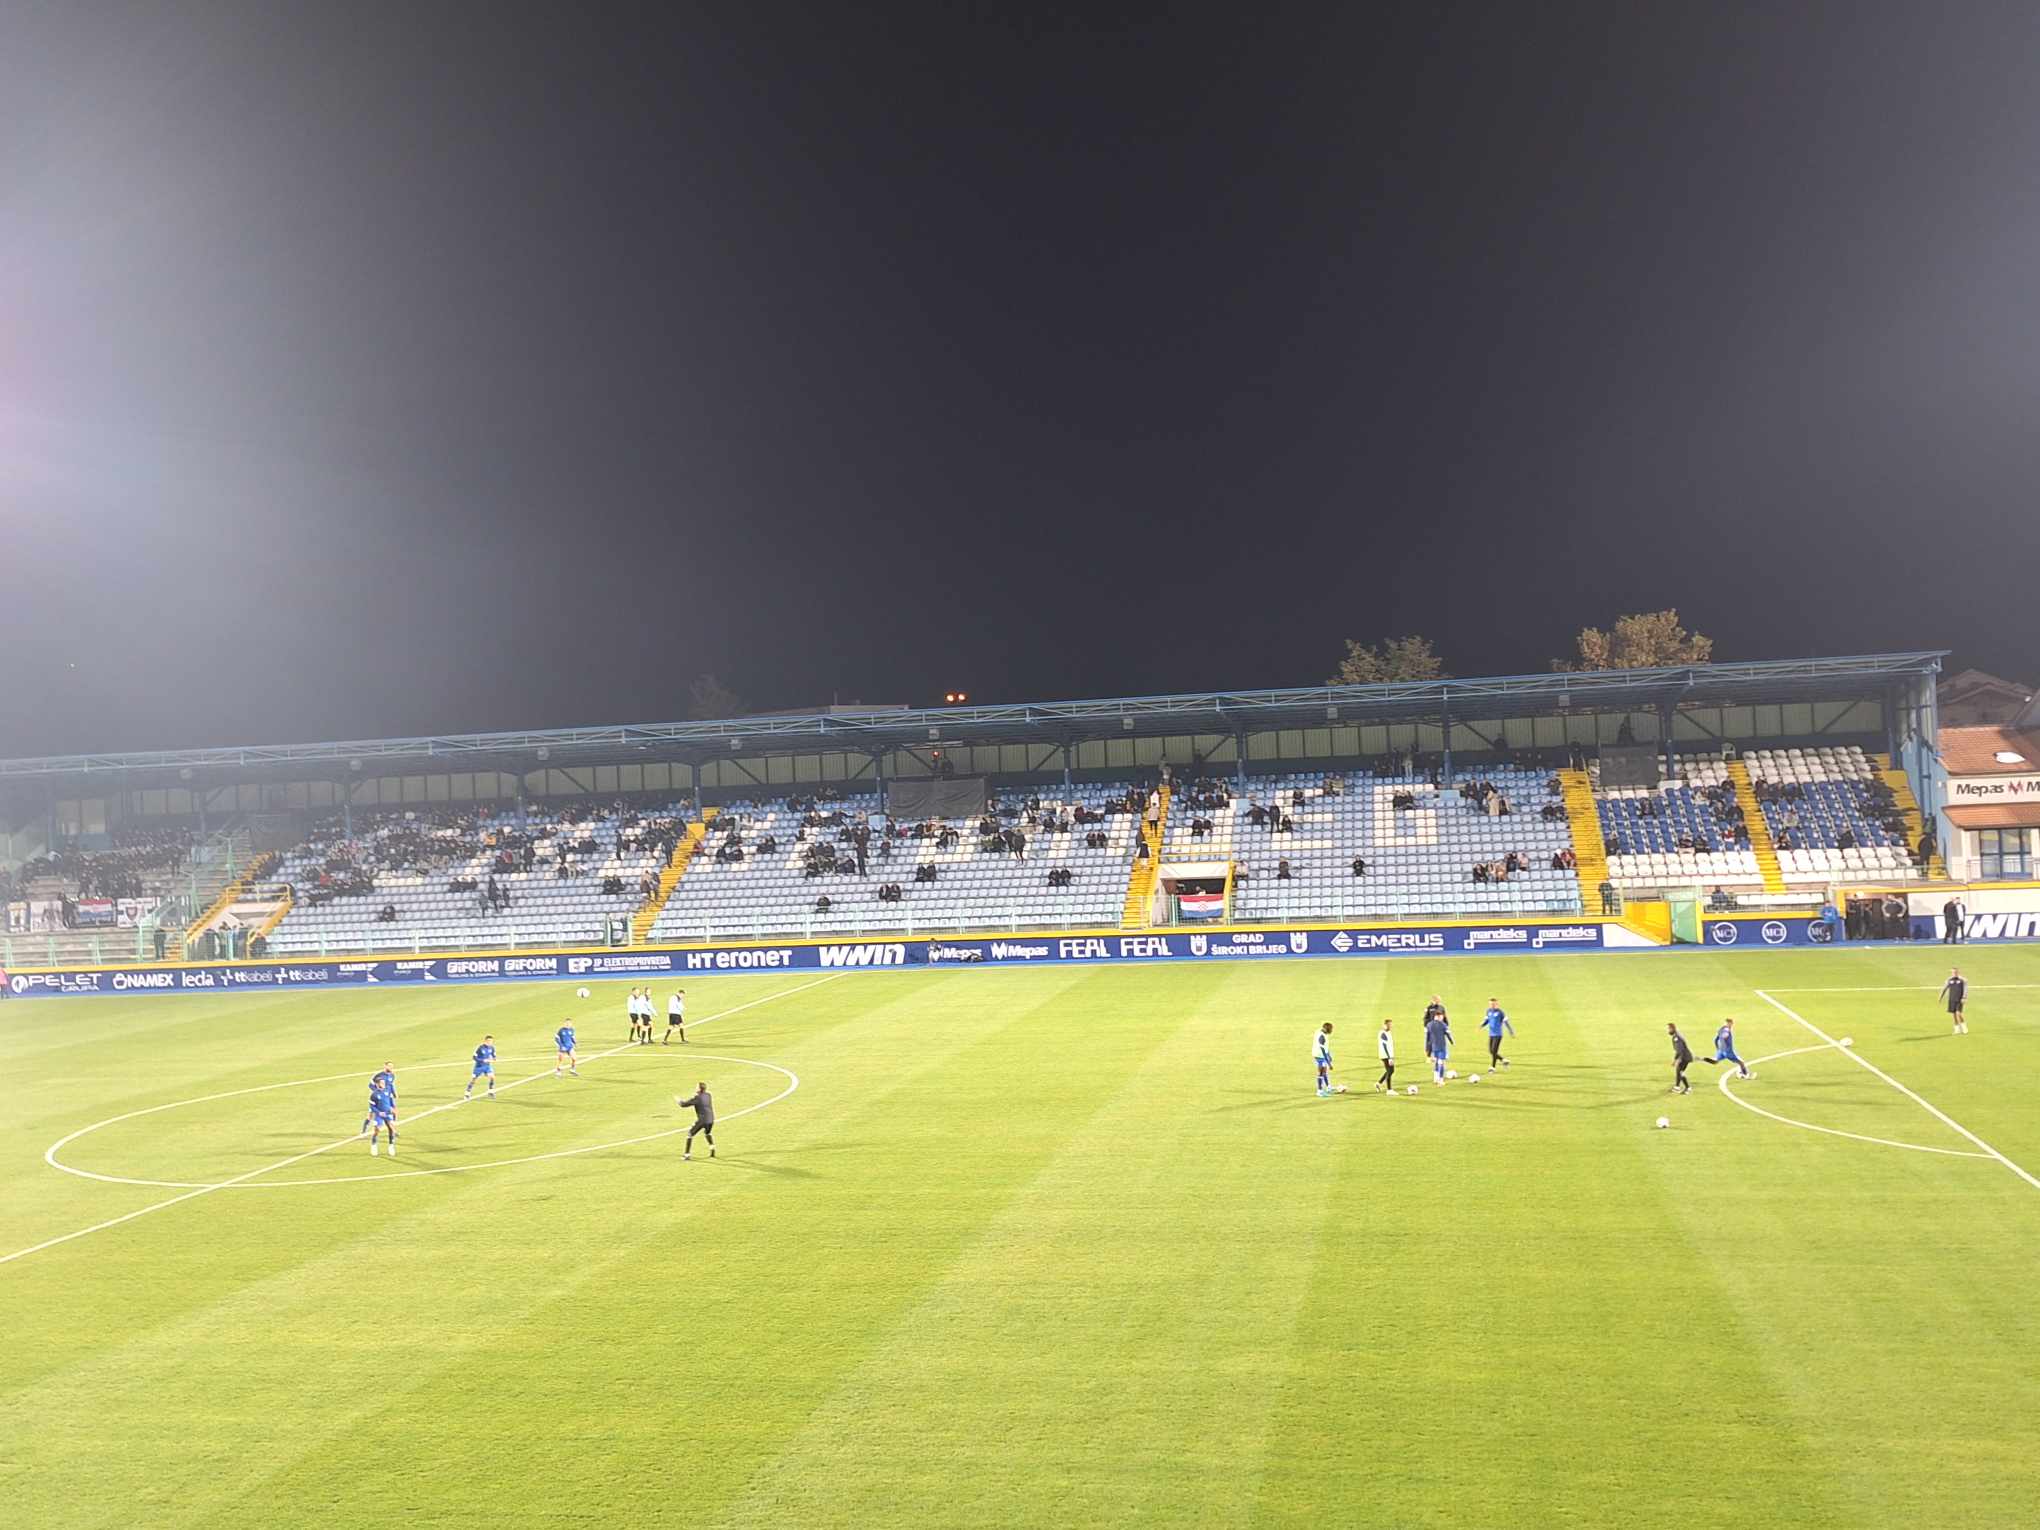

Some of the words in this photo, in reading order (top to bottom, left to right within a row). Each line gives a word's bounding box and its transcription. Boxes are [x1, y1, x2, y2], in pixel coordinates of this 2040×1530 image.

[1956, 784, 2005, 797] Mepas
[1232, 933, 1265, 943] GRAD
[1469, 928, 1527, 942] mandeks
[1538, 926, 1597, 940] mandeks
[1120, 937, 1173, 957] FEAL
[1357, 933, 1444, 948] EMERUS
[1008, 945, 1049, 959] Mepas
[1059, 938, 1111, 958] FEAL
[1211, 944, 1247, 955] ŠIROKI
[1248, 944, 1288, 954] BRIJEG
[28, 973, 102, 987] PELET
[127, 973, 174, 988] NAMEX
[181, 971, 215, 987] leda
